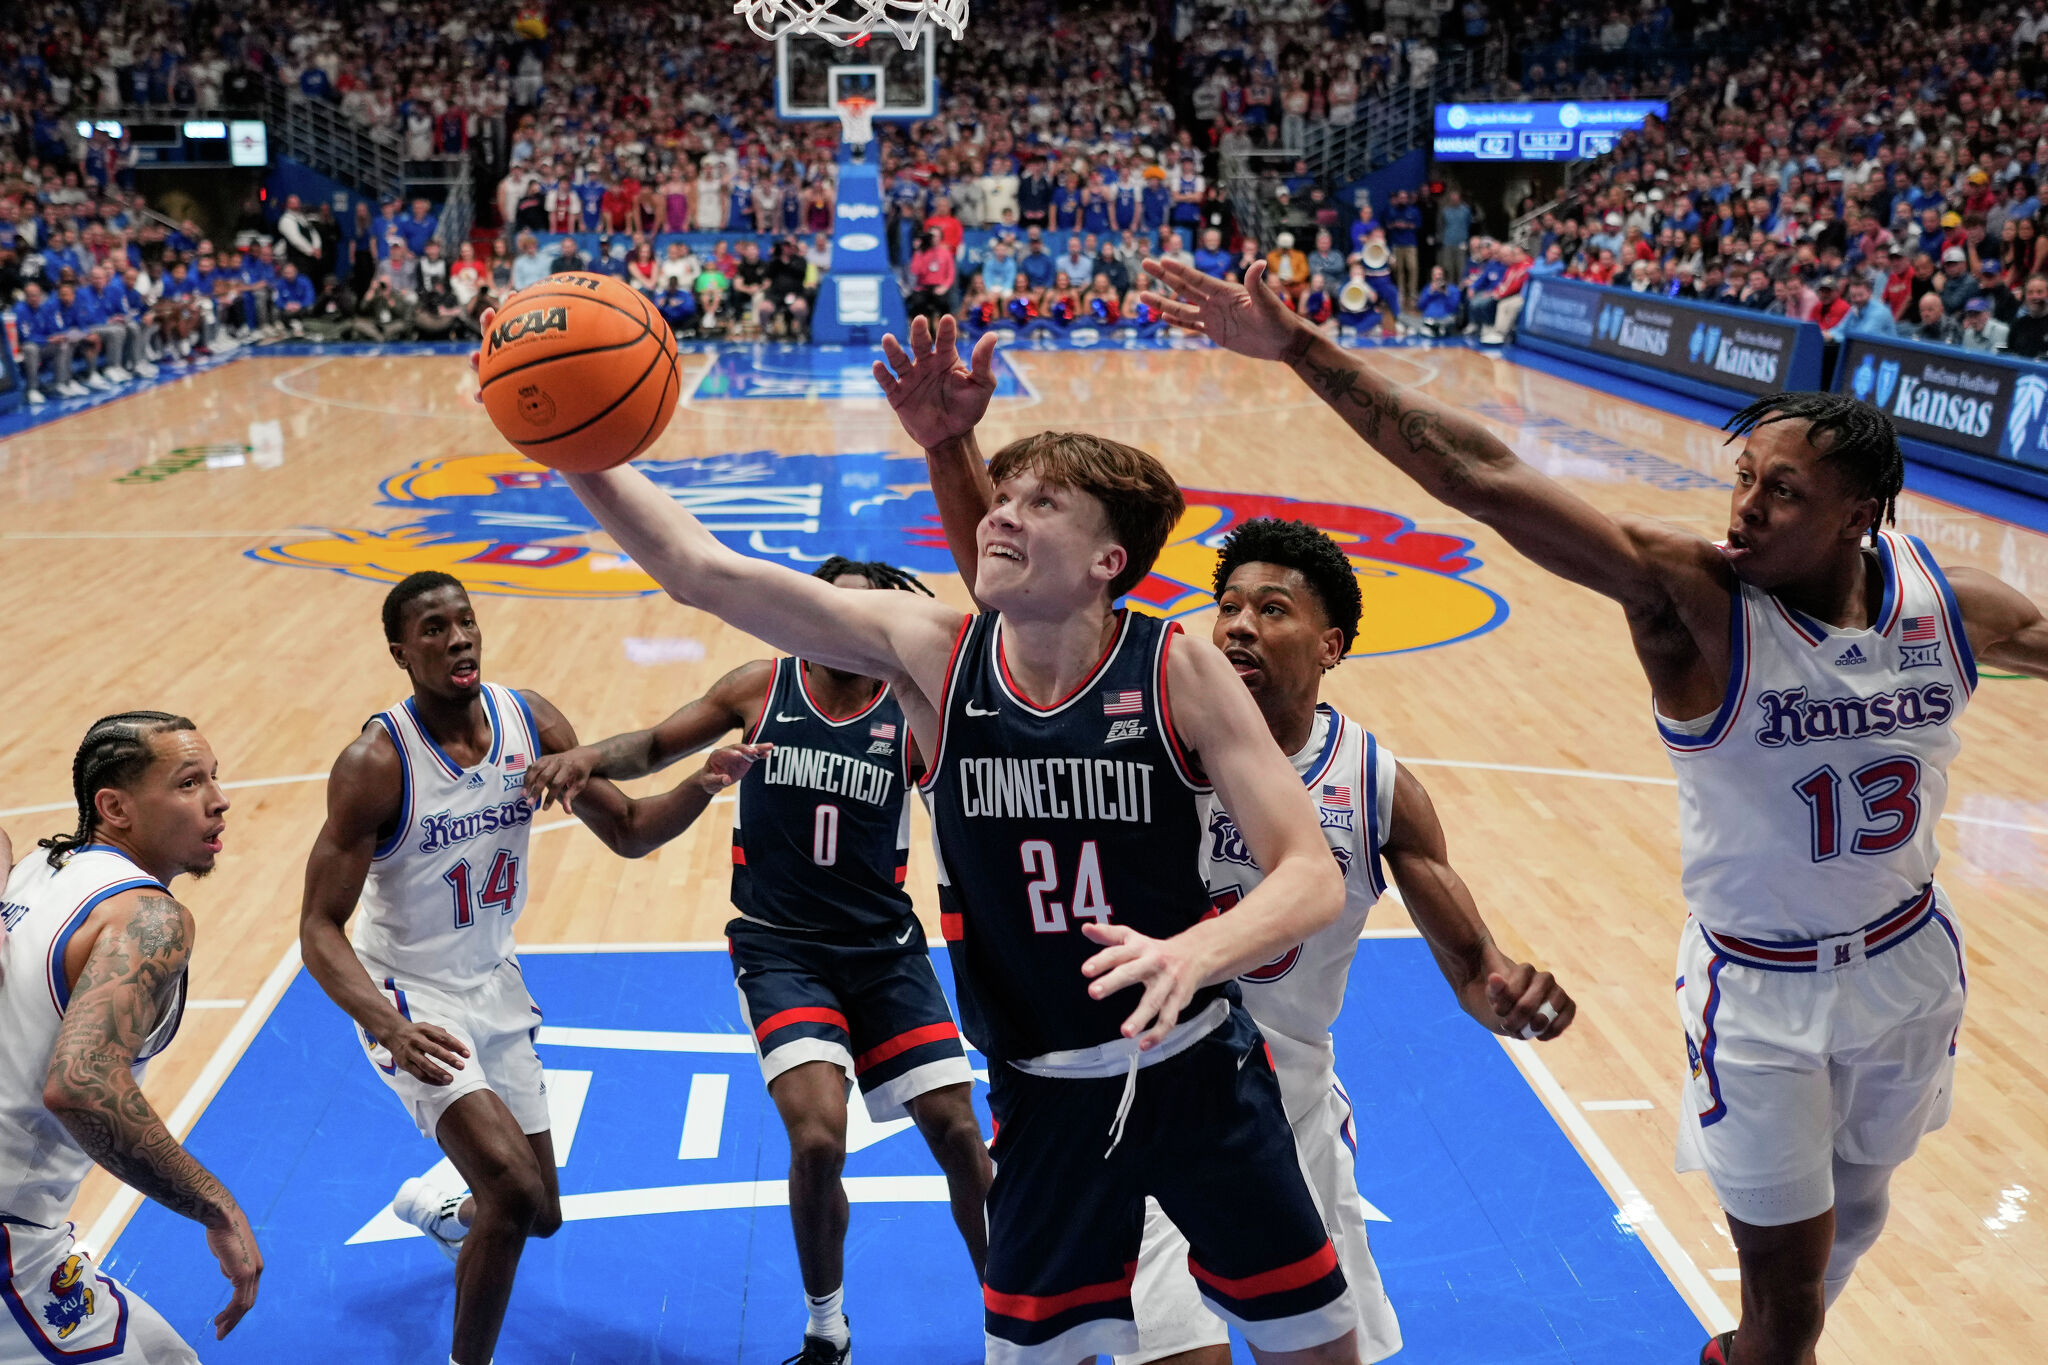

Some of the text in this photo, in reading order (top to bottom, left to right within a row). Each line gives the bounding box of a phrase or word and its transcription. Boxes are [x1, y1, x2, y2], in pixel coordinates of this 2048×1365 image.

[487, 306, 568, 357] NCAA
[1618, 314, 1670, 357] Kansas
[1714, 336, 1779, 384] Kansas
[1893, 374, 1995, 438] Kansas
[1834, 655, 1867, 666] adidas
[1106, 726, 1148, 739] EAST
[1110, 719, 1140, 730] BIG
[1755, 682, 1954, 749] Kansas
[764, 745, 895, 808] CONNECTICUT
[959, 757, 1154, 824] CONNECTICUT
[420, 797, 534, 853] Kansas
[813, 803, 839, 867] 0
[1323, 809, 1350, 829] XII
[1792, 754, 1921, 864] 13
[443, 848, 520, 929] 14
[1019, 839, 1114, 934] 24
[61, 1296, 78, 1315] KU
